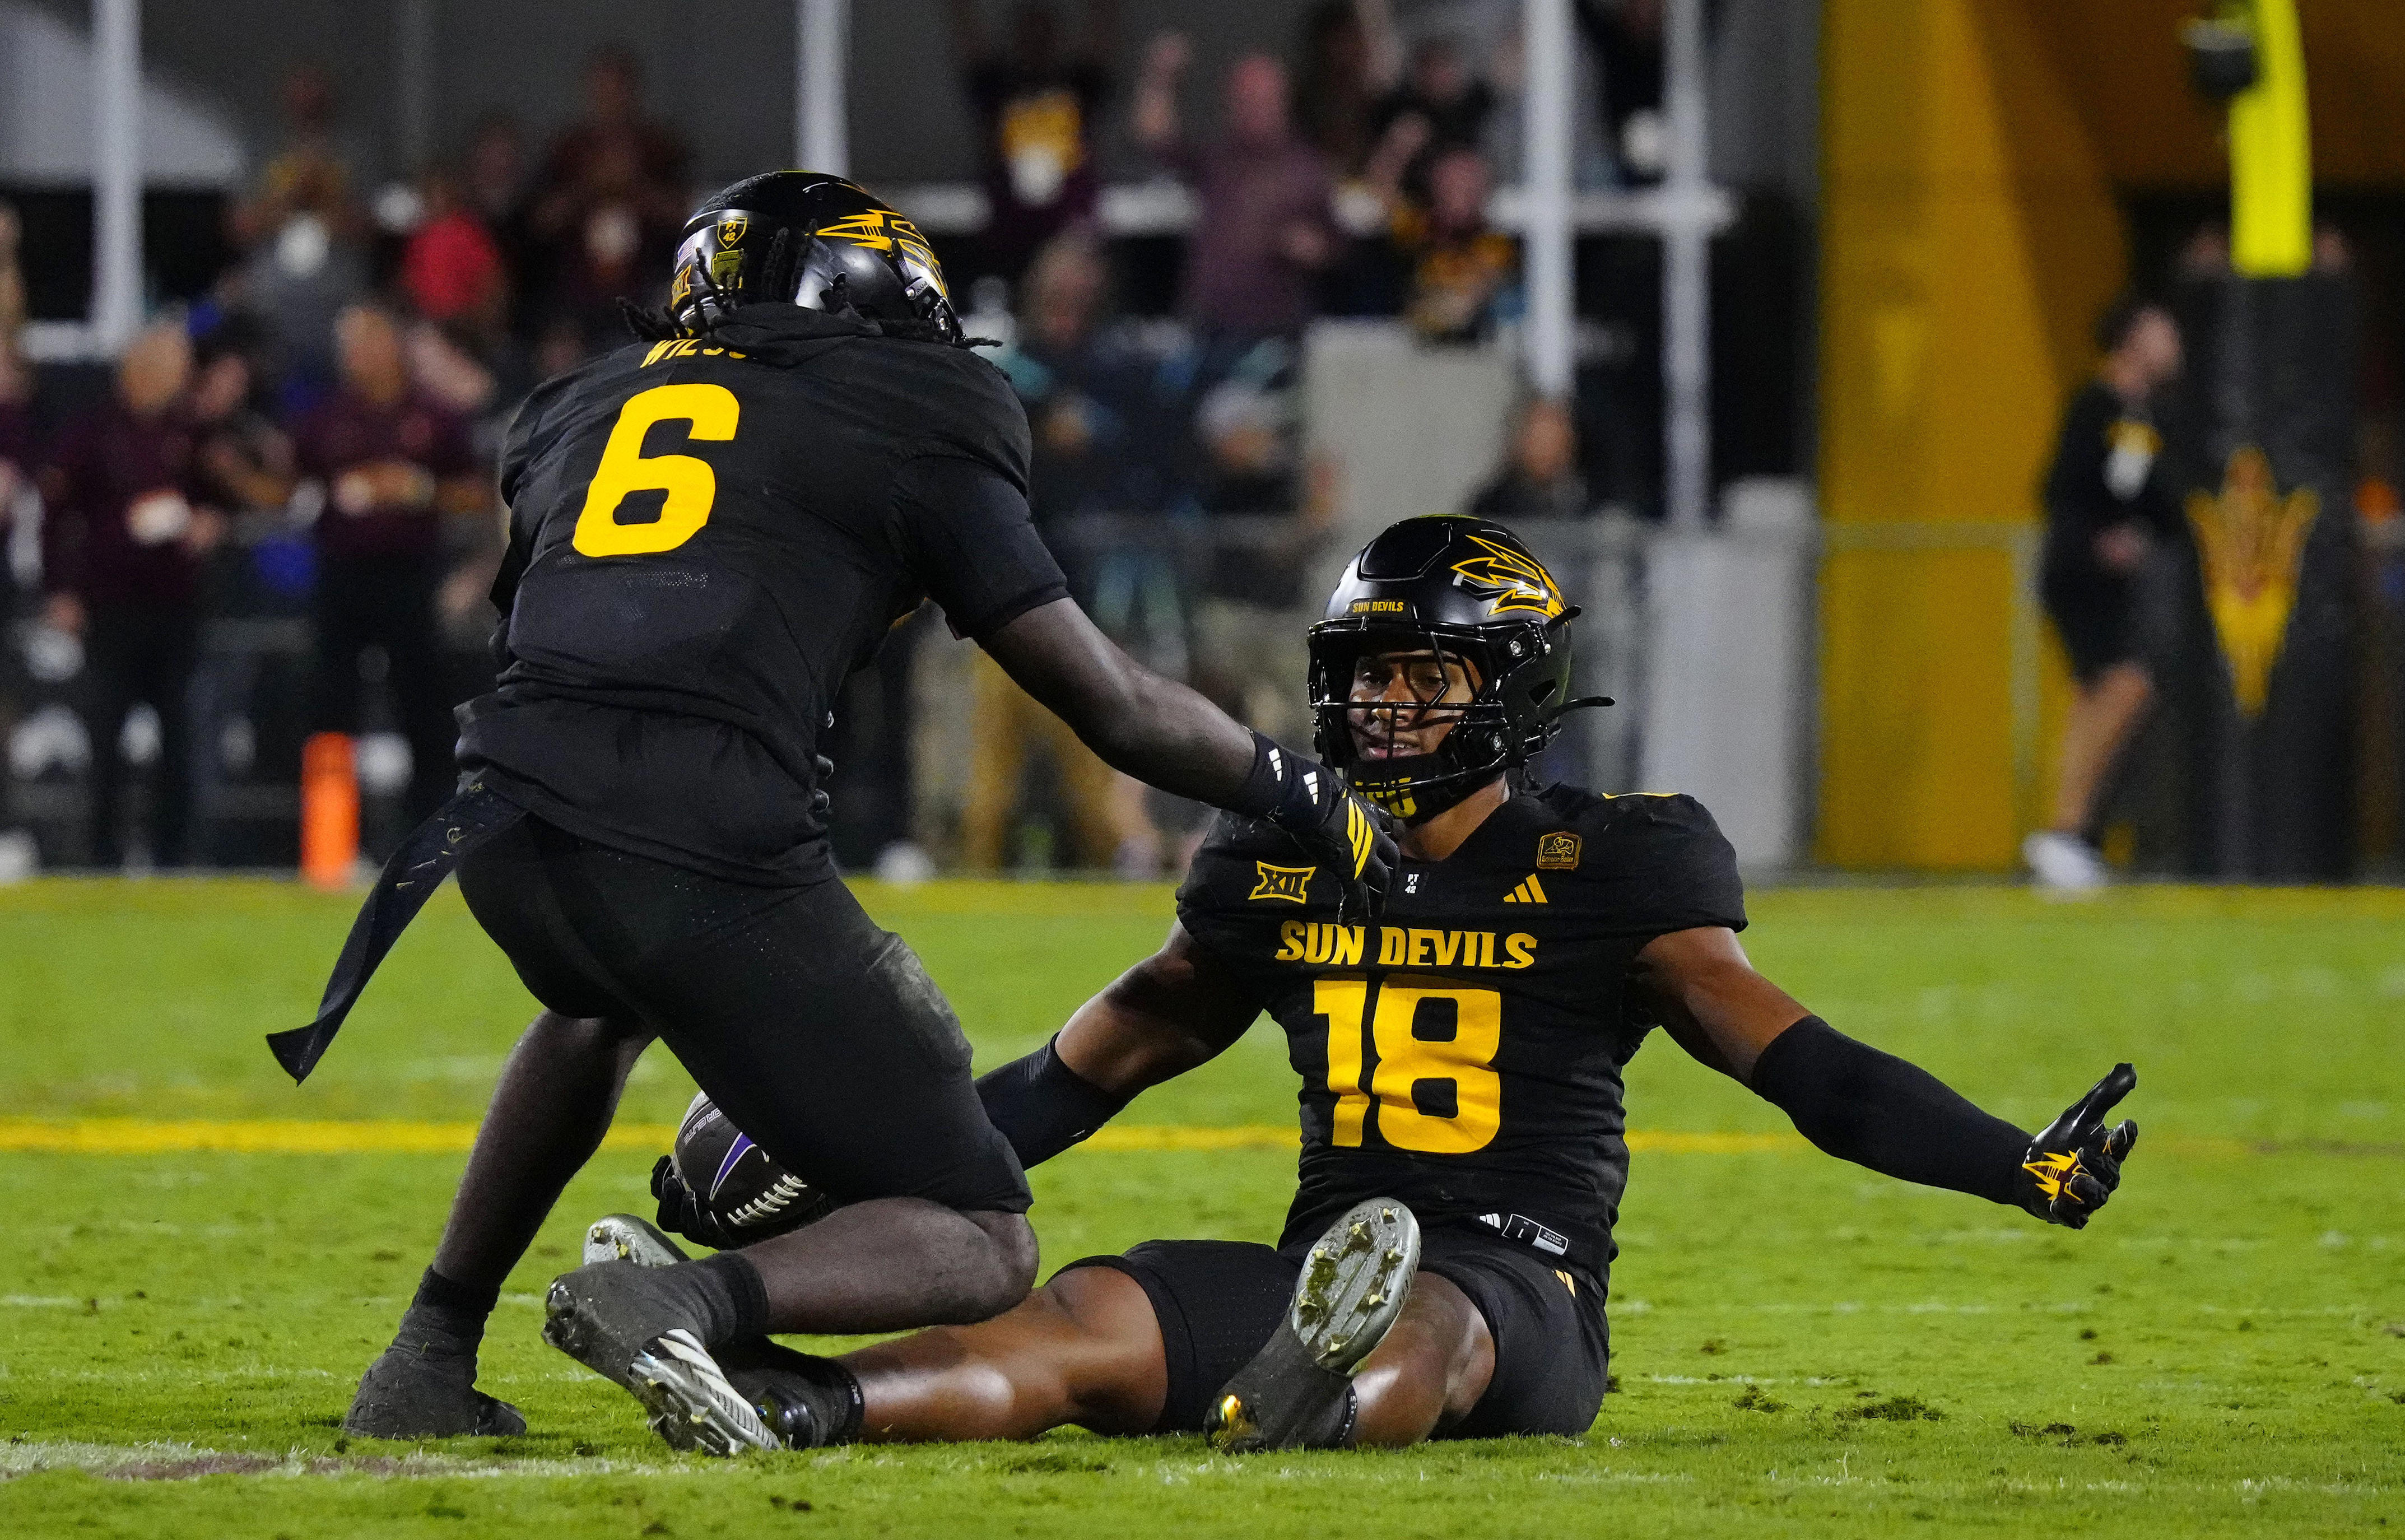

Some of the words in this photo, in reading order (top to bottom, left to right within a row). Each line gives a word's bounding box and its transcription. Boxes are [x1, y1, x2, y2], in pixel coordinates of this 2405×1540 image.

[723, 232, 736, 241] 42
[572, 383, 740, 557] 6
[1353, 602, 1370, 613] SUN
[1372, 601, 1404, 612] DEVILS
[1253, 864, 1312, 901] XII
[1405, 885, 1417, 894] 42
[1407, 874, 1419, 882] PT
[1274, 920, 1367, 966] SUN
[1377, 926, 1538, 969] DEVILS
[1313, 973, 1501, 1154] 18
